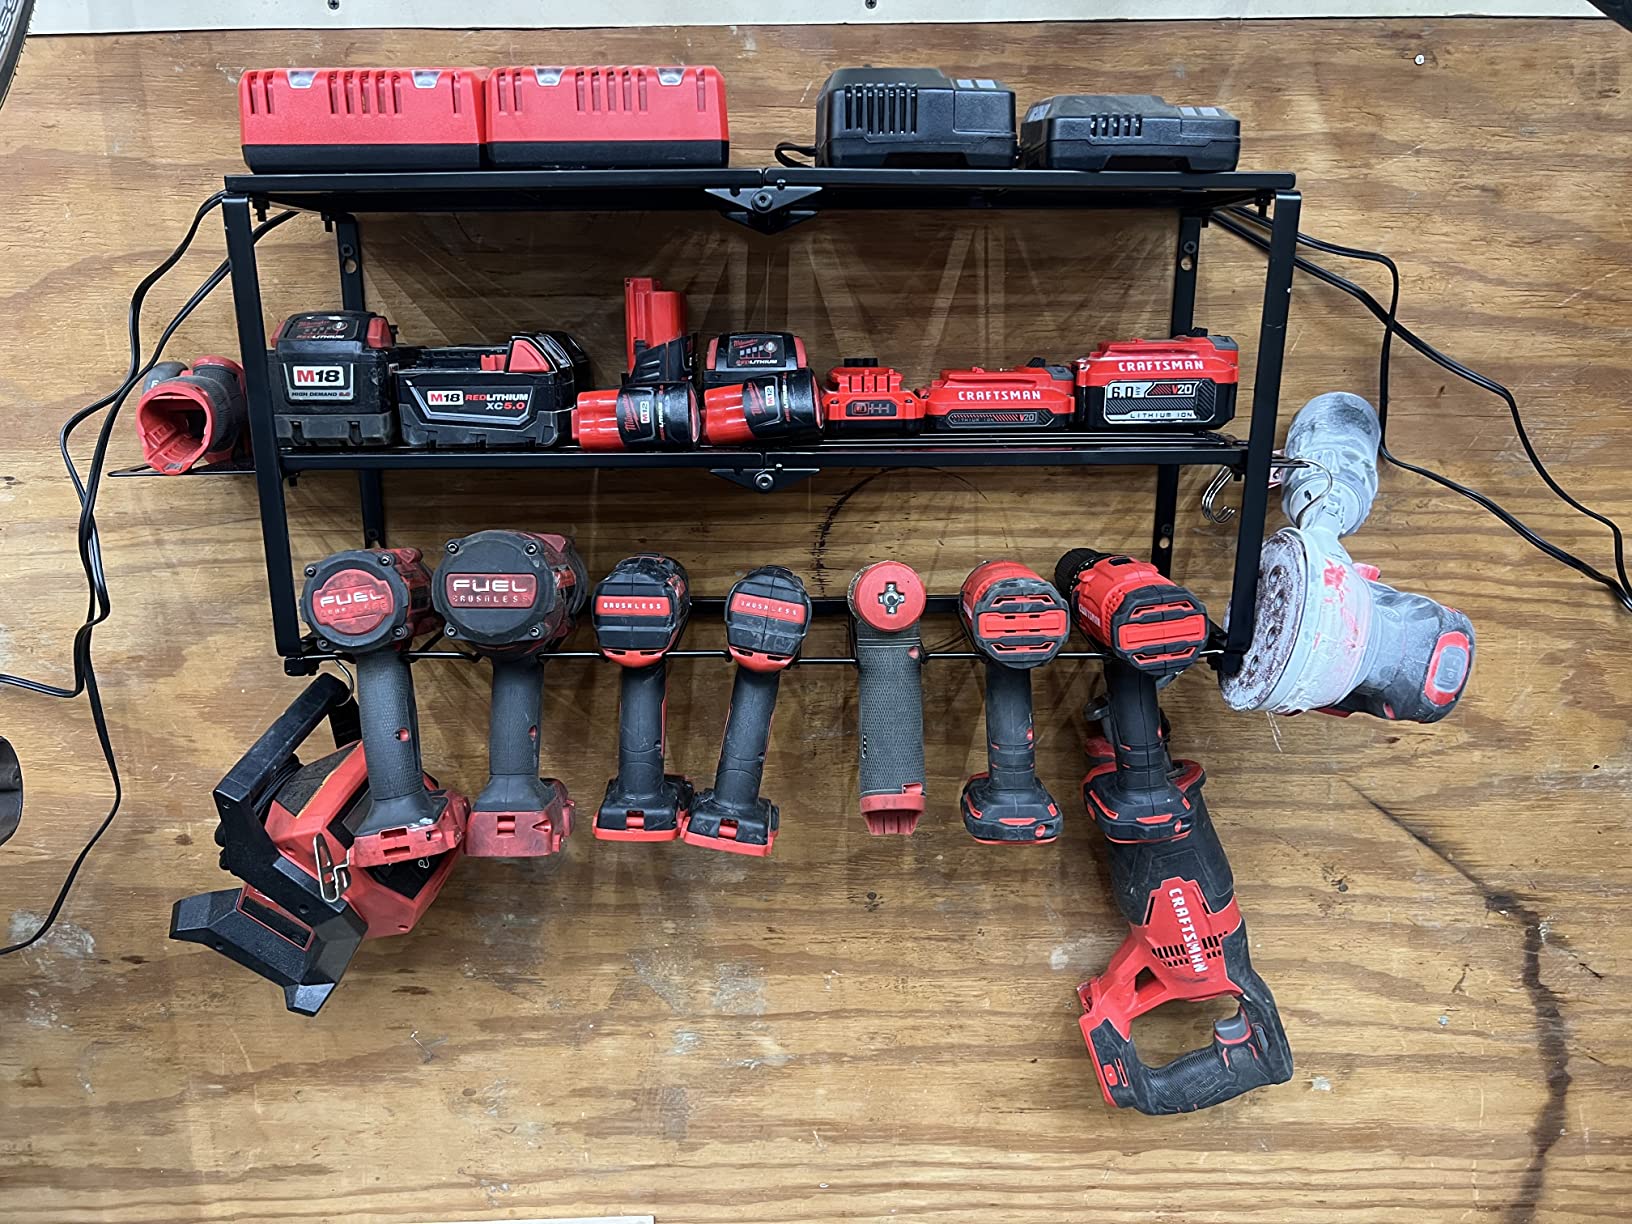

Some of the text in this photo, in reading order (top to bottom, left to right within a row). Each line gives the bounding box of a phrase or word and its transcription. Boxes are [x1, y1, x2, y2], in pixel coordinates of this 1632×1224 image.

[1118, 360, 1204, 372] CRAFTSMAN
[296, 369, 340, 382] M18
[430, 393, 528, 402] M18 REDLITHIUM
[766, 387, 774, 404] M12
[958, 390, 1040, 401] CRAFTSMAN
[1112, 386, 1134, 399] 6.0
[1172, 384, 1192, 394] V20
[485, 402, 525, 410] XC5.0
[641, 402, 649, 422] M12
[1020, 413, 1034, 422] V20
[1130, 411, 1172, 419] LITHIUM
[452, 579, 528, 593] FUEL
[320, 590, 384, 608] FUEL
[602, 601, 662, 610] BRUSHLESS
[1169, 887, 1208, 973] CRAFTSMAN
